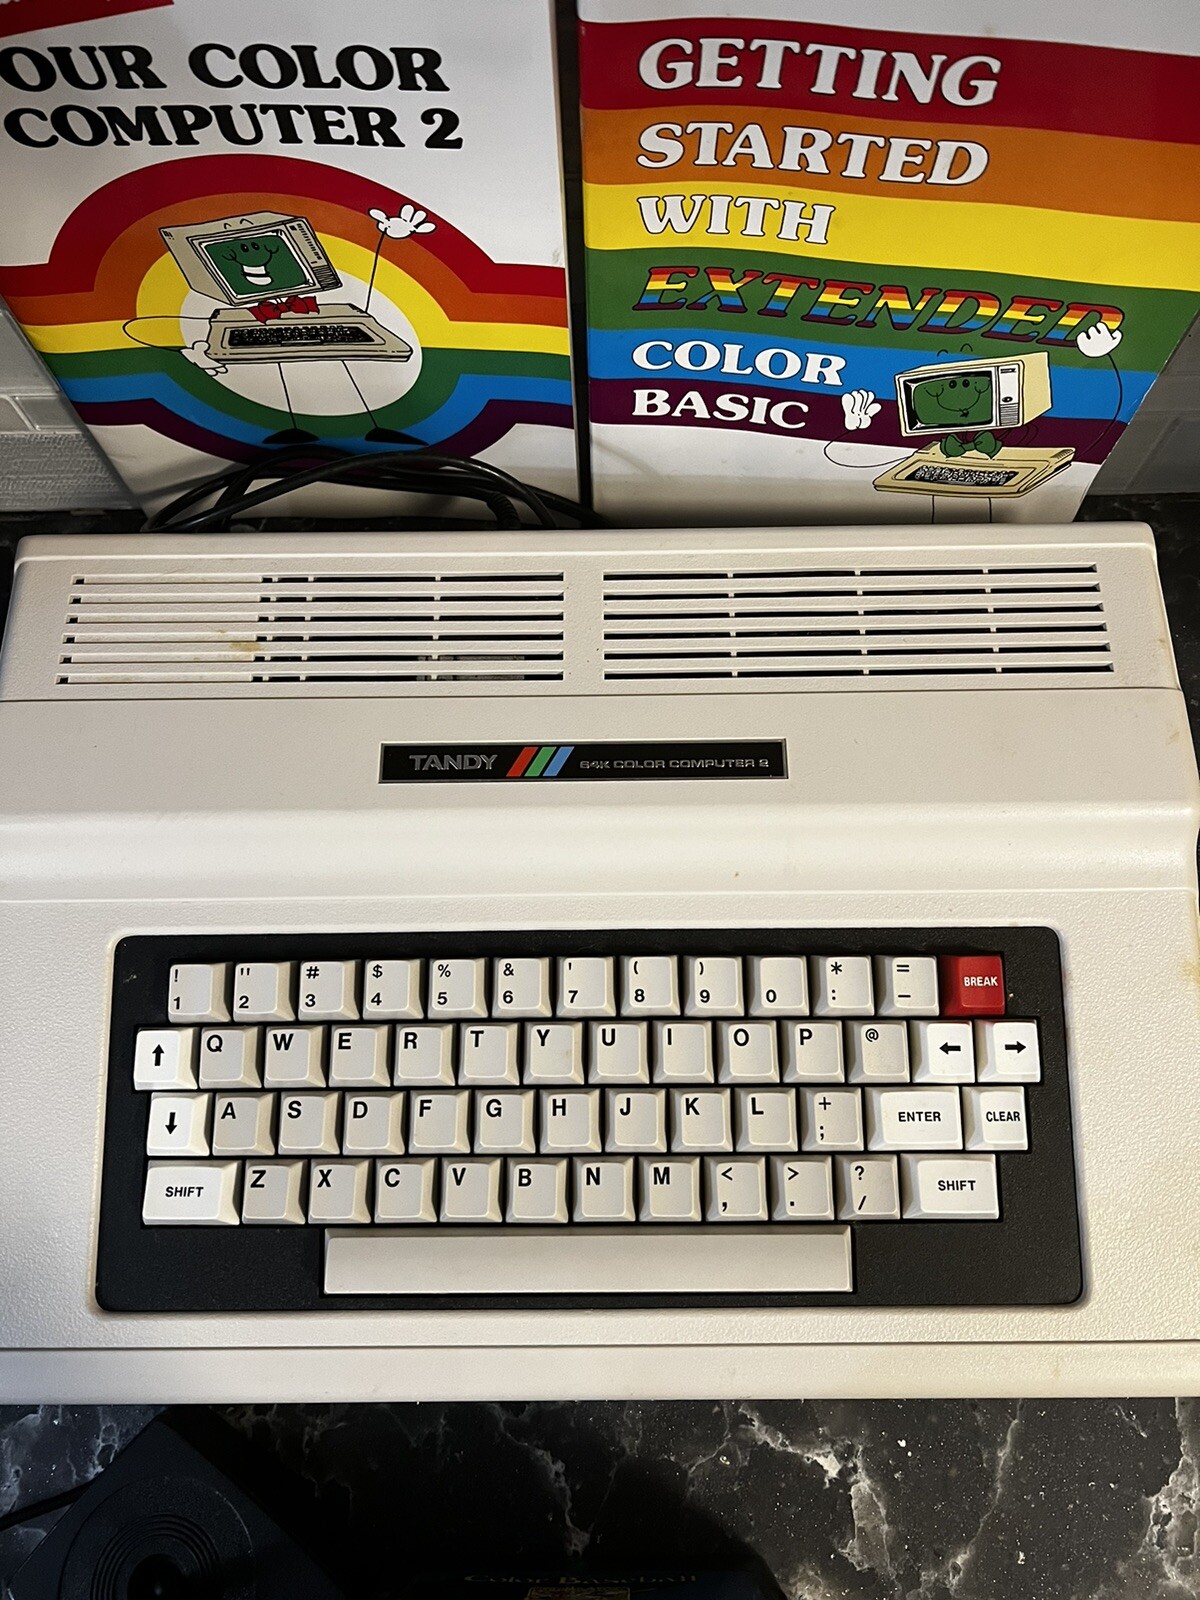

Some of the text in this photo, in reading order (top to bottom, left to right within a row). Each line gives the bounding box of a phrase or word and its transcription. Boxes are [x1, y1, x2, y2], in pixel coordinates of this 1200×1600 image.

[0, 43, 450, 92] OUR COLOR
[638, 37, 1002, 107] GETTING
[4, 104, 463, 149] COMPUTER 2
[635, 122, 990, 187] STARTED
[636, 194, 836, 245] WITH
[631, 266, 1126, 349] EXTENDED
[631, 340, 847, 386] COLOR
[631, 388, 811, 429] BASIC
[409, 754, 498, 771] TANDY
[579, 758, 769, 769] 64K COLOR COMPUTER 2
[306, 965, 320, 979] #
[372, 963, 383, 979] $
[437, 963, 452, 978] %
[503, 962, 515, 977] &
[896, 964, 910, 973] =
[963, 976, 998, 987] BREAK
[173, 996, 181, 1010] 1
[238, 995, 250, 1009] 2
[304, 993, 316, 1008] 3
[370, 992, 383, 1006] 4
[437, 991, 448, 1006] 5
[502, 990, 514, 1005] 6
[568, 989, 579, 1004] 7
[634, 988, 646, 1003] 8
[699, 989, 711, 1004] 9
[765, 989, 777, 1004] 0
[206, 1034, 223, 1053] Q
[272, 1033, 294, 1051] W
[337, 1032, 353, 1050] E
[403, 1031, 418, 1050] R
[469, 1029, 485, 1048] T
[536, 1028, 551, 1047] Y
[601, 1028, 616, 1047] U
[733, 1028, 750, 1047] O
[799, 1028, 813, 1046] P
[865, 1028, 879, 1043] @
[220, 1101, 237, 1120] A
[287, 1100, 302, 1119] S
[352, 1100, 368, 1119] D
[419, 1099, 433, 1118] F
[485, 1098, 502, 1118] G
[552, 1098, 567, 1117] H
[619, 1097, 631, 1116] J
[685, 1097, 700, 1116] K
[751, 1096, 765, 1116] L
[818, 1096, 832, 1111] +
[898, 1111, 942, 1123] ENTER
[985, 1111, 1021, 1123] CLEAR
[250, 1169, 267, 1189] Z
[317, 1168, 333, 1188] X
[384, 1167, 401, 1188] C
[451, 1167, 467, 1187] V
[518, 1168, 532, 1187] B
[585, 1166, 601, 1186] N
[653, 1166, 671, 1186] M
[721, 1167, 733, 1181] <
[787, 1166, 800, 1181] >
[854, 1165, 865, 1181] ?
[165, 1186, 204, 1198] SHIFT
[937, 1179, 976, 1192] SHIFT
[857, 1195, 867, 1211] /
